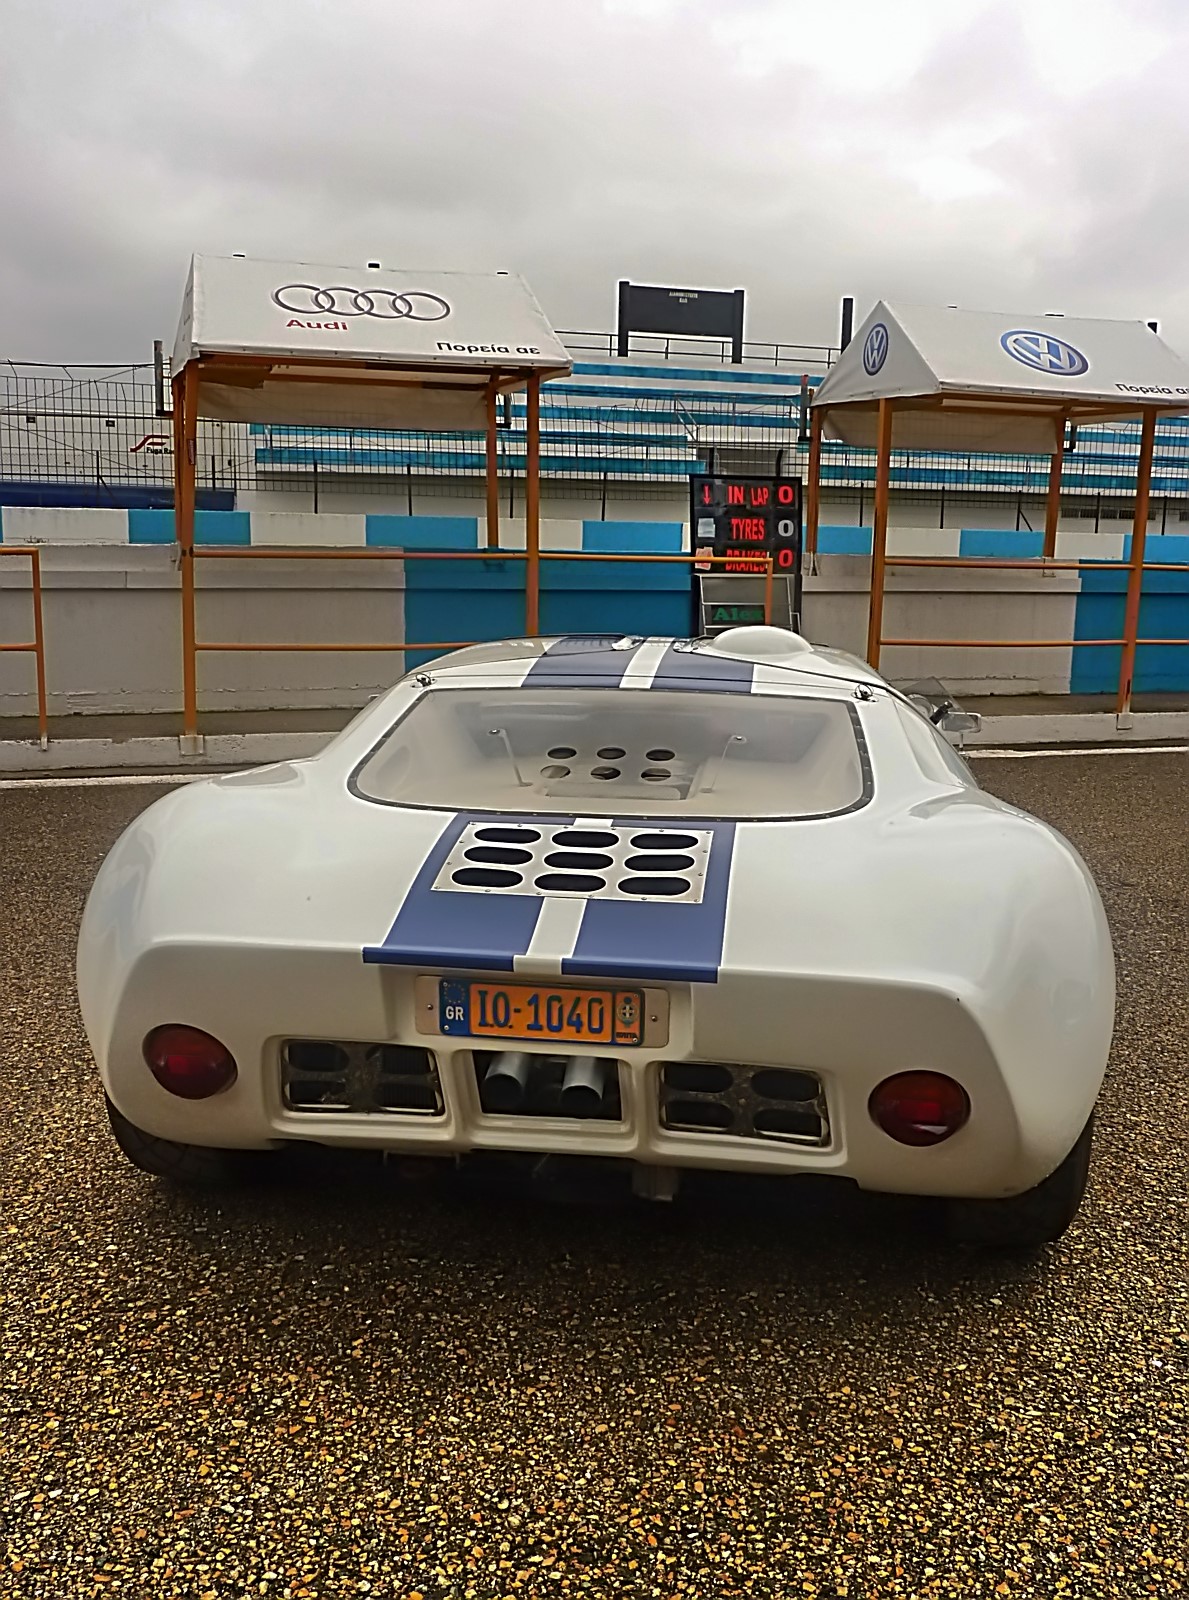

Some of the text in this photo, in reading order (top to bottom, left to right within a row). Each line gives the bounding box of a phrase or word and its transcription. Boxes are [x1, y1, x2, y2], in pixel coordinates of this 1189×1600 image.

[286, 319, 348, 331] Audi
[436, 342, 510, 354] Πορεία
[1115, 383, 1173, 394] Πορεία
[146, 446, 162, 455] Fuga
[727, 485, 744, 504] IN
[751, 486, 769, 506] LAP
[731, 518, 765, 540] TYRES
[726, 549, 766, 571] BRAKES
[445, 1005, 464, 1021] GR
